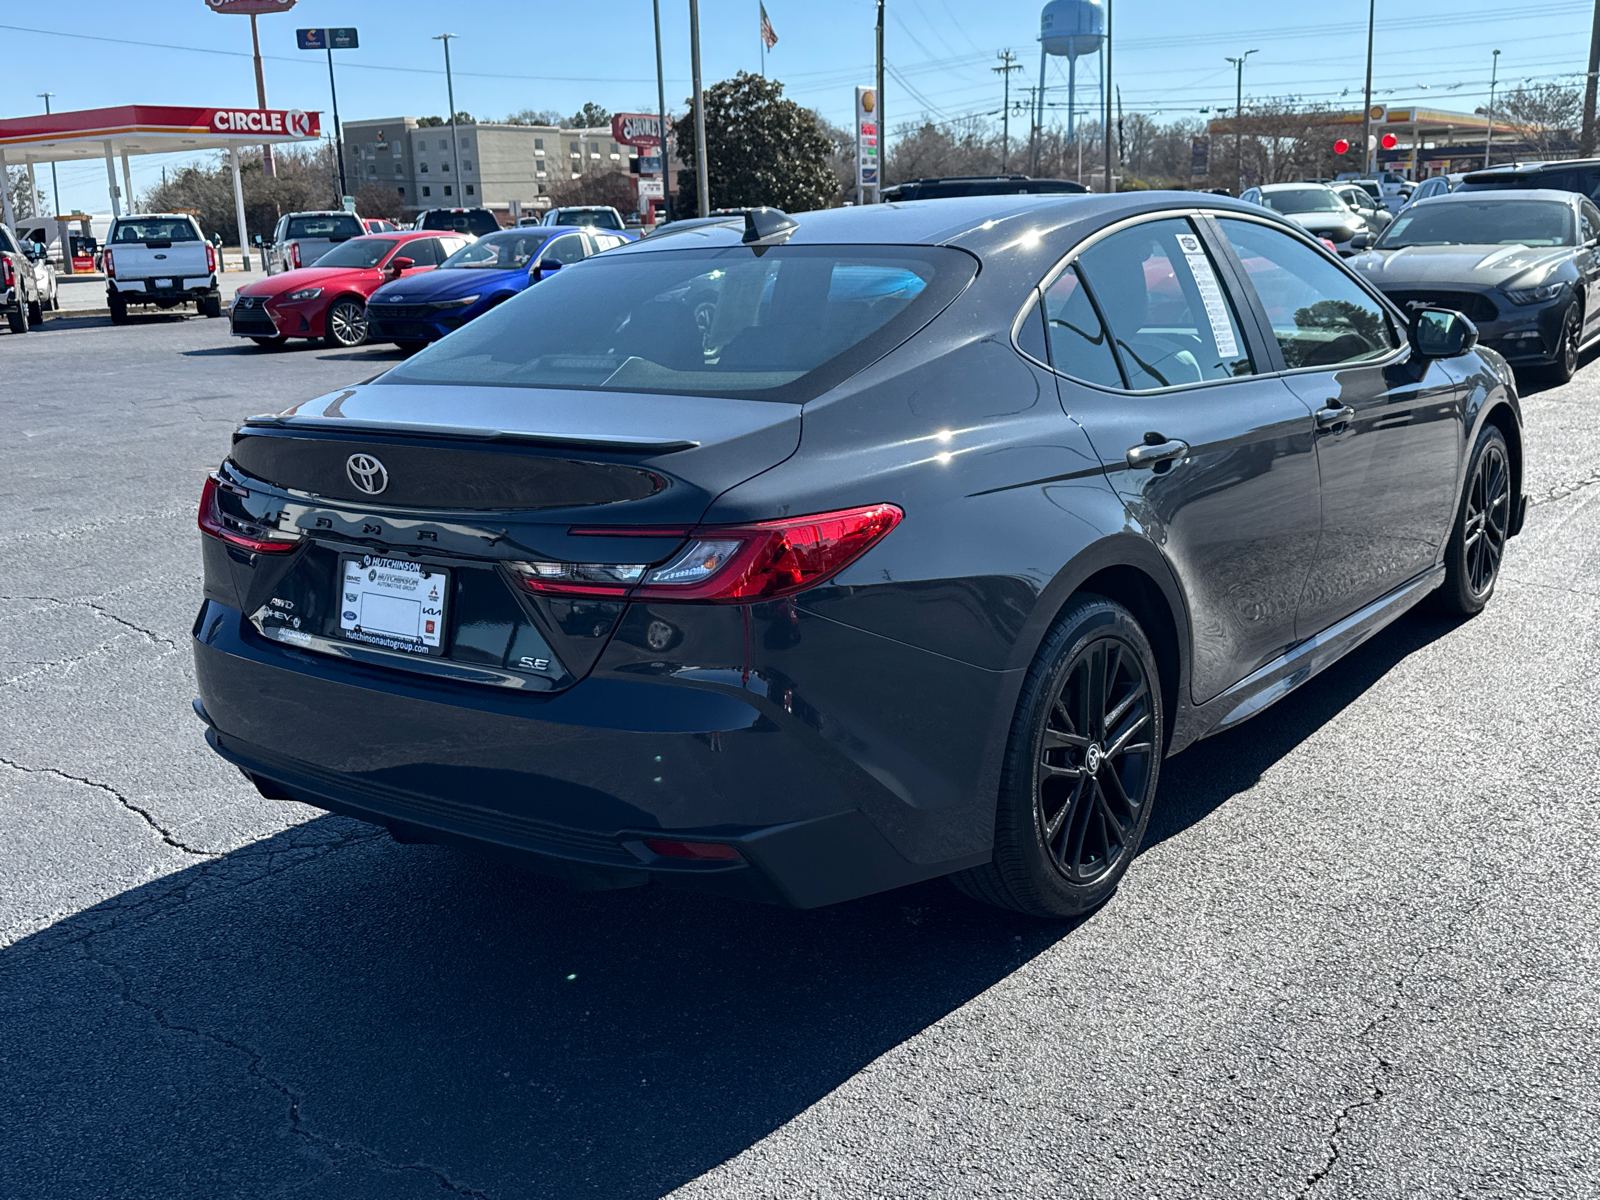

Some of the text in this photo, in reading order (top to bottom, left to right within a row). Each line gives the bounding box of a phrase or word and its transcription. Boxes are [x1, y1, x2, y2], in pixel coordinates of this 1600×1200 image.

[214, 111, 307, 133] CIRCLE K
[372, 557, 421, 572] HUTCHINSON
[377, 582, 402, 590] AUTOMOTIVE
[270, 597, 294, 609] AWD
[345, 630, 429, 654] Hutchinsonautogroup.com
[518, 656, 550, 670] SE
